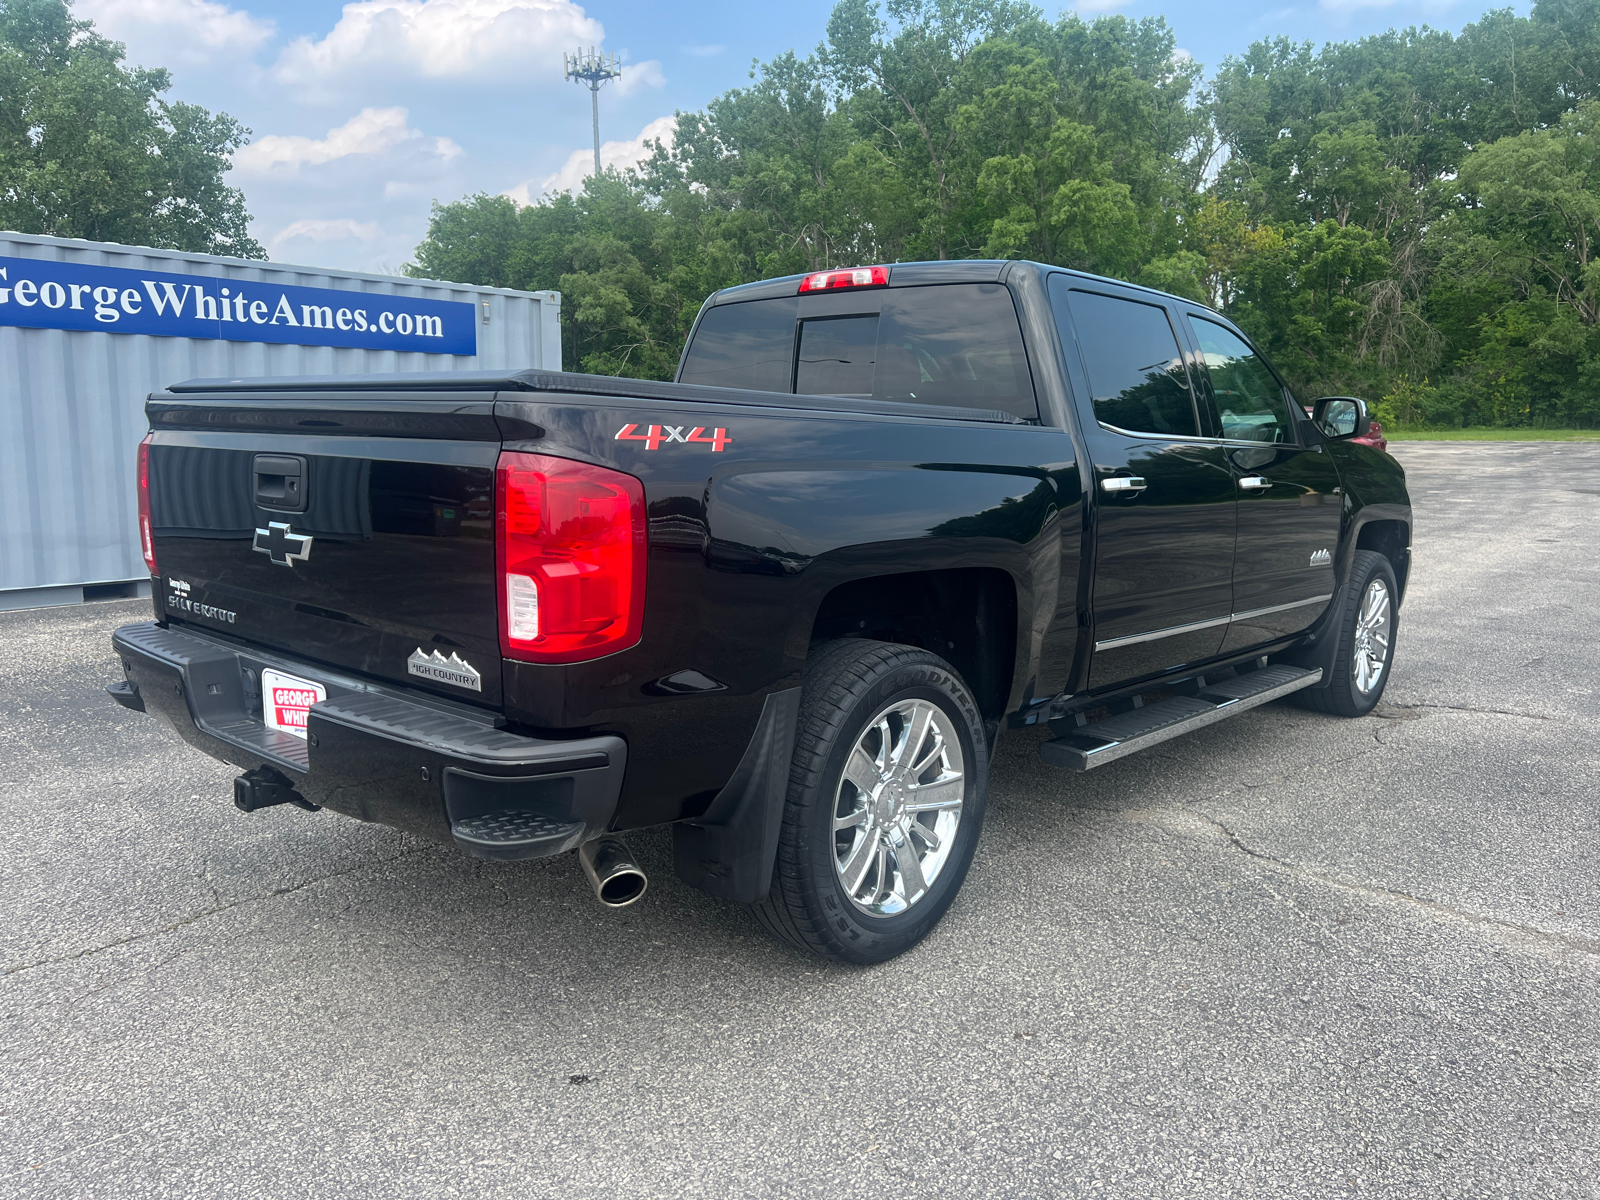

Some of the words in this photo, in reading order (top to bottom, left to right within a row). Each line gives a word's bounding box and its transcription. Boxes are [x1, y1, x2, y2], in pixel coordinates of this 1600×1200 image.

[168, 595, 237, 624] SILVERADO
[433, 669, 476, 686] COUNTRY
[275, 689, 315, 707] GEORGE
[880, 669, 983, 746] GOODYEAR
[282, 708, 309, 727] WHIT
